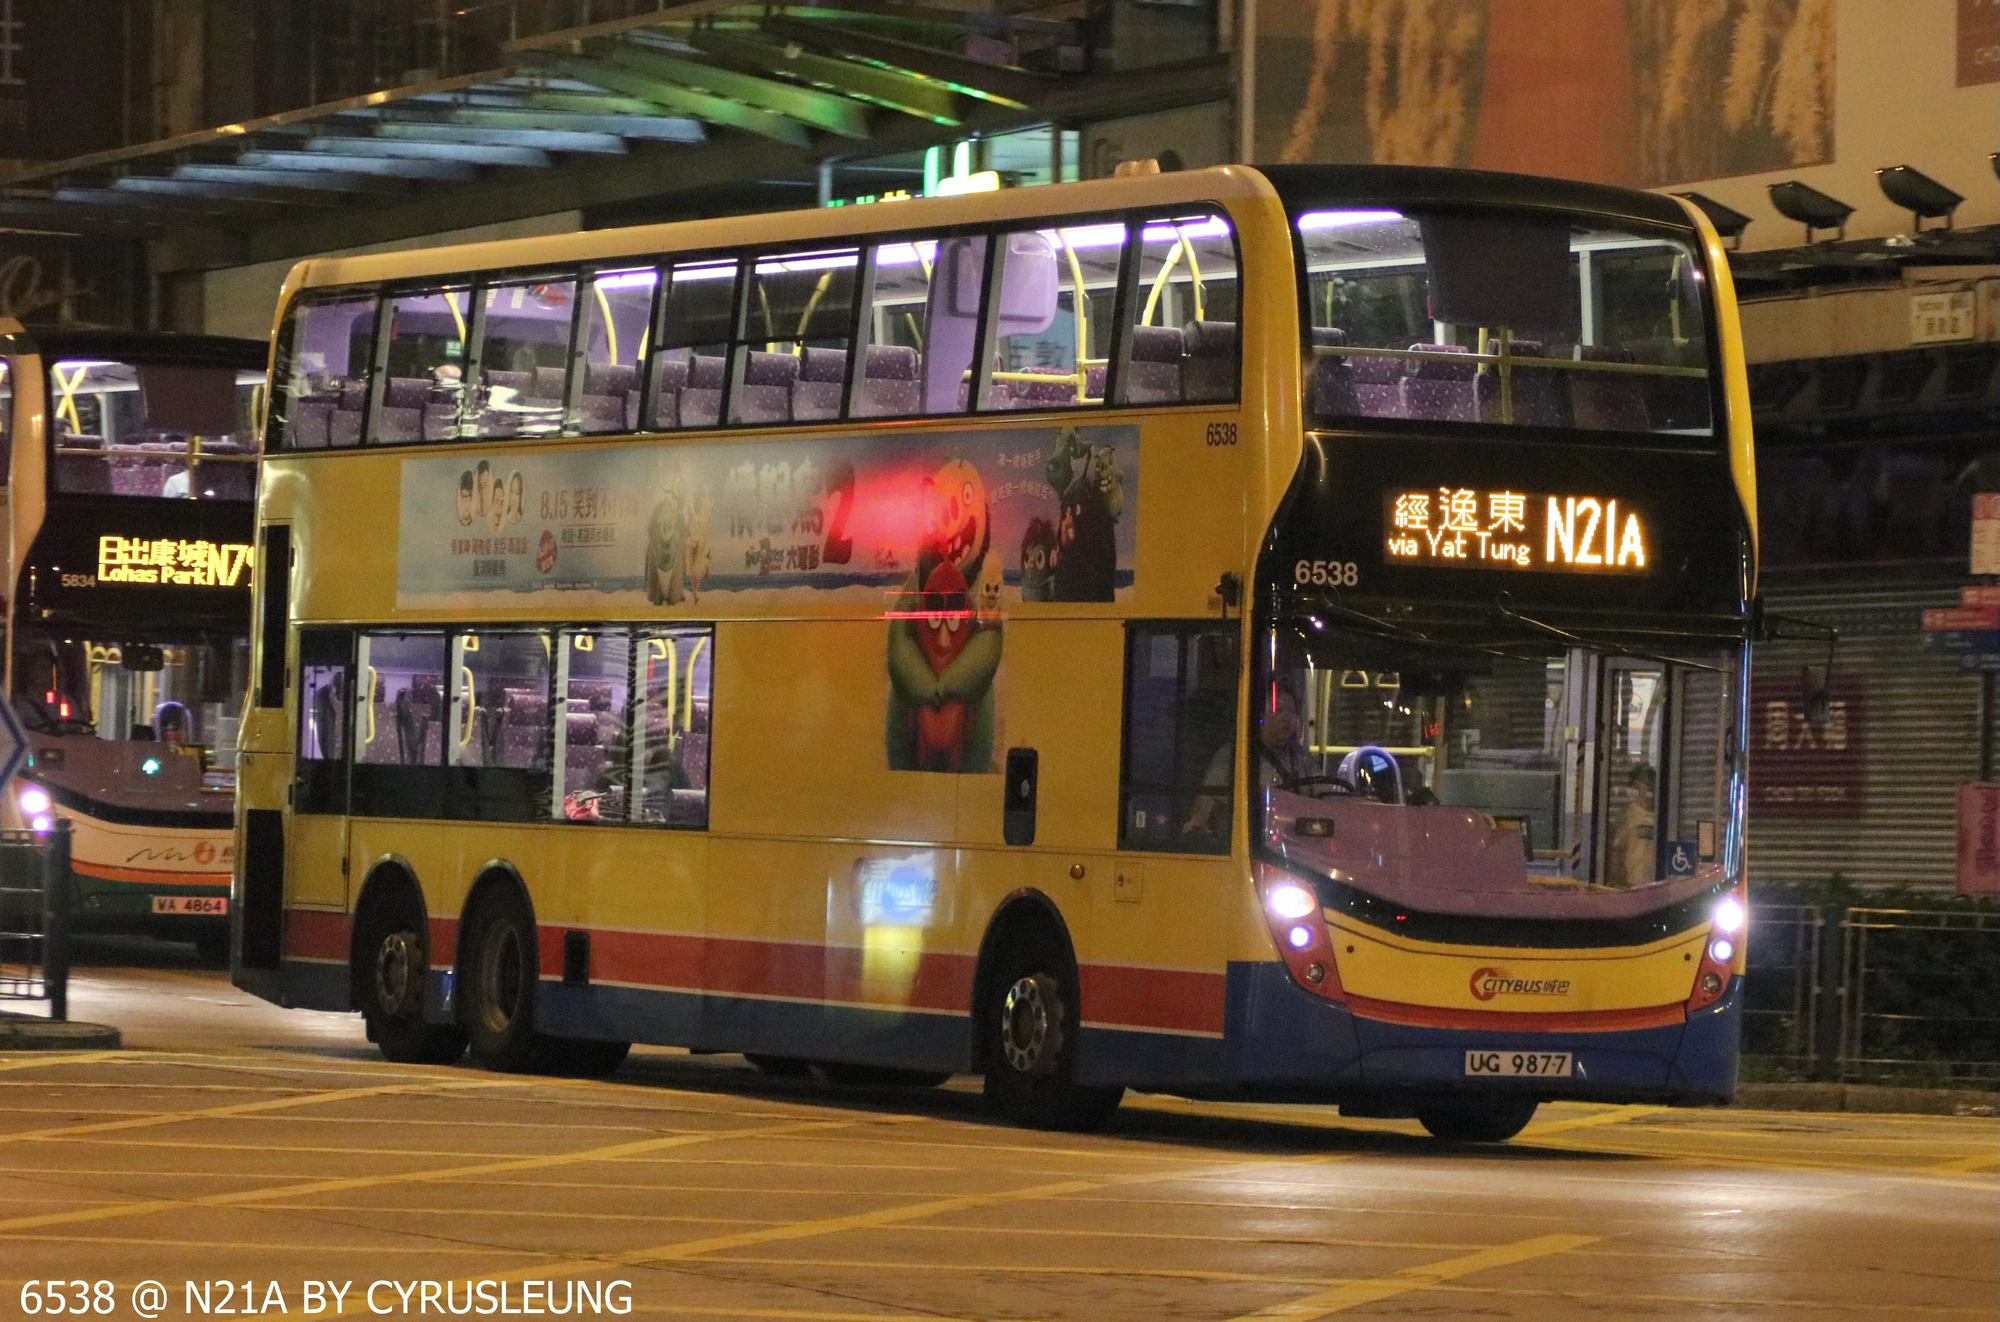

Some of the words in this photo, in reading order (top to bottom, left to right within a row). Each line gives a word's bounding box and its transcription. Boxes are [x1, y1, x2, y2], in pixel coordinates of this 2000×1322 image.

[1207, 422, 1237, 446] 6538
[540, 489, 568, 522] 8.15
[1394, 487, 1526, 532] 經逸東
[1545, 497, 1645, 567] N21A
[98, 536, 209, 567] 日出康城
[1388, 531, 1418, 556] via
[1426, 529, 1468, 559] Yat
[1475, 531, 1531, 565] Tung
[61, 573, 96, 588] 5834
[98, 564, 159, 583] Lohas
[160, 565, 208, 586] Park
[1294, 559, 1359, 587] 6538
[184, 899, 222, 912] 4864
[1483, 978, 1543, 993] CITYBUS
[1470, 1053, 1500, 1073] UG
[1512, 1054, 1567, 1075] 9877
